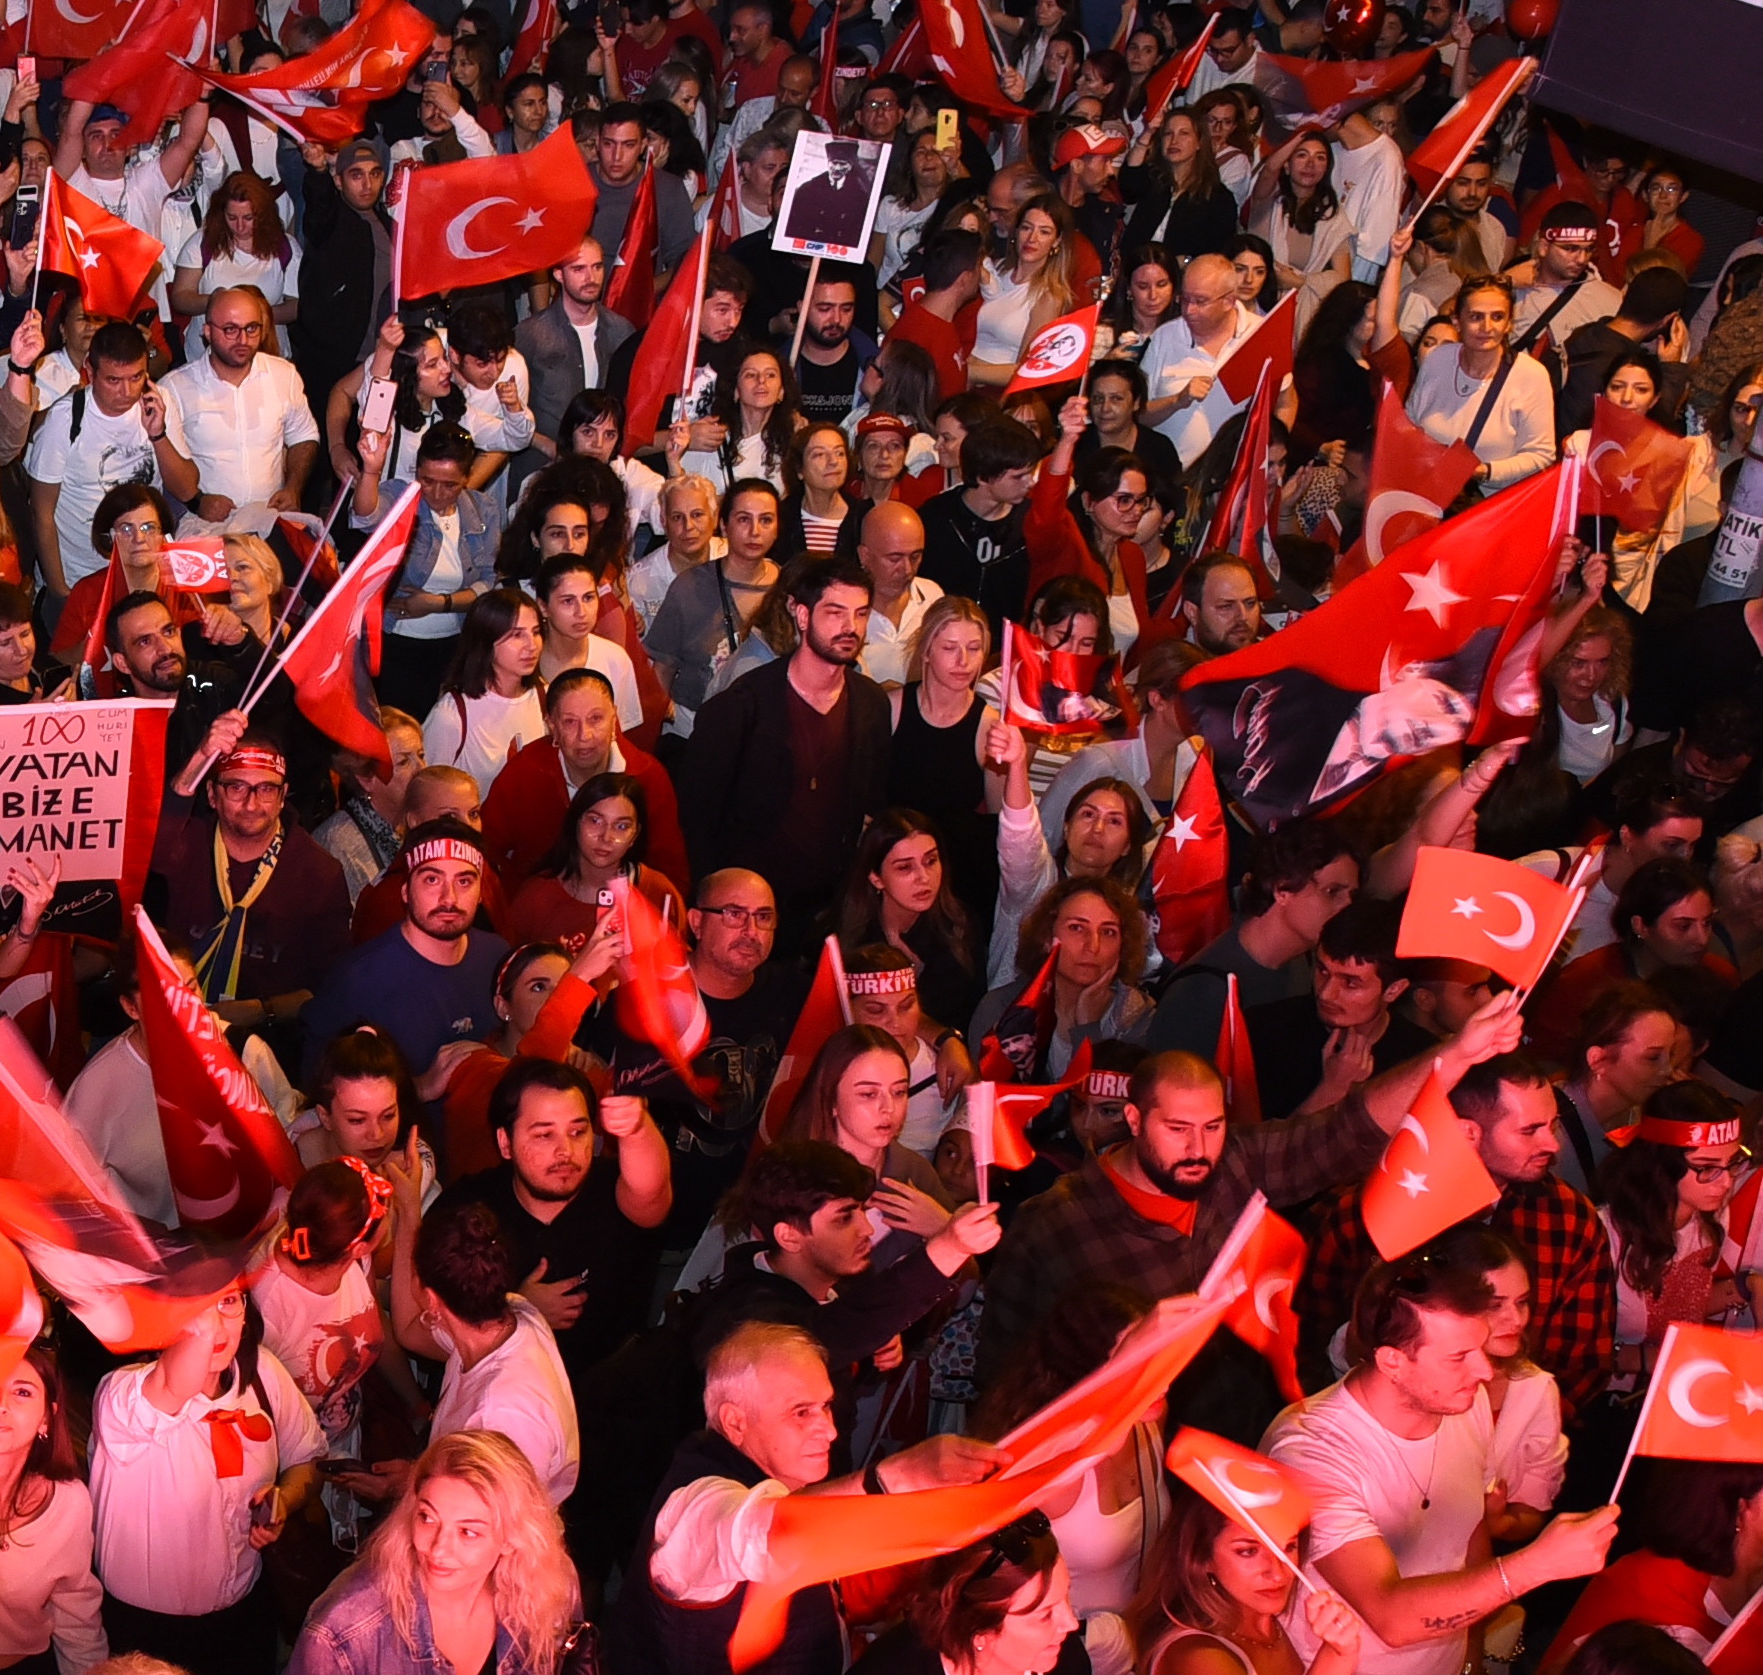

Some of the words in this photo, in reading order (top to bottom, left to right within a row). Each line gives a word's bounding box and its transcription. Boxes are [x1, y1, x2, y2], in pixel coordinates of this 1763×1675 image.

[1719, 532, 1737, 557] TL
[1730, 568, 1748, 581] 51
[96, 708, 128, 719] CUM
[21, 714, 85, 747] 100
[99, 732, 123, 742] YET
[2, 784, 94, 819] BİZE
[1082, 1072, 1131, 1099] ÜRK
